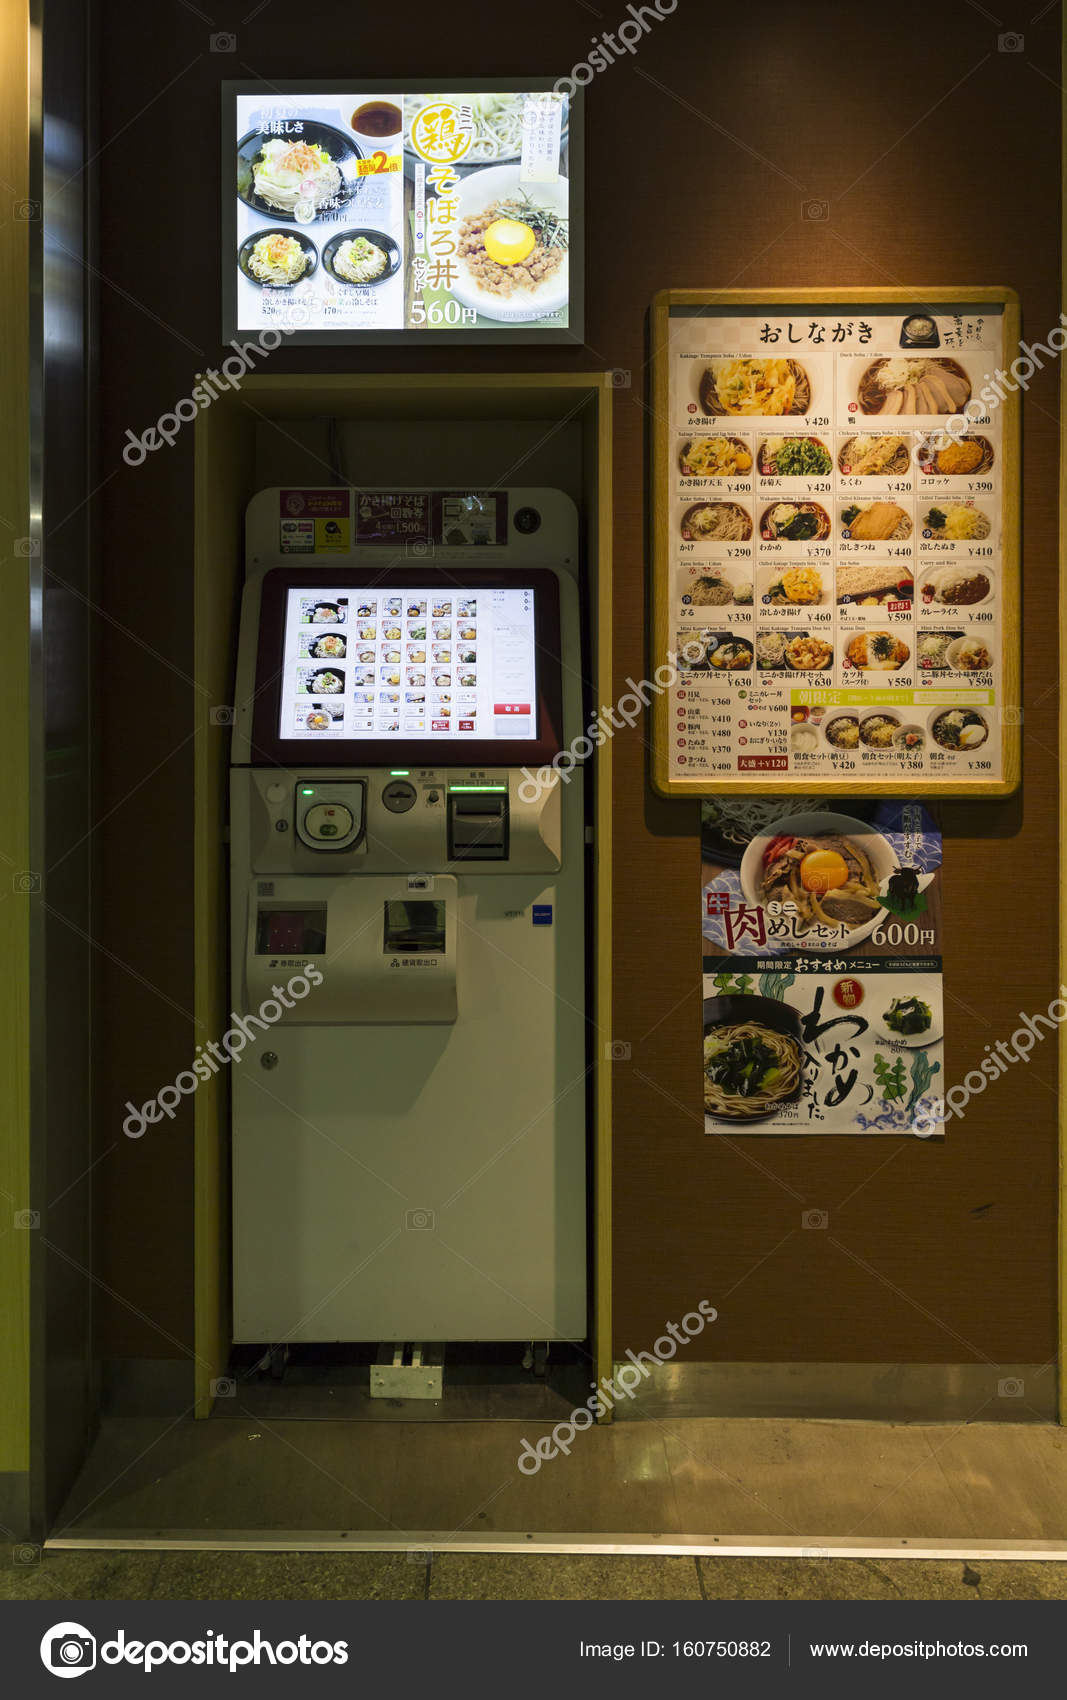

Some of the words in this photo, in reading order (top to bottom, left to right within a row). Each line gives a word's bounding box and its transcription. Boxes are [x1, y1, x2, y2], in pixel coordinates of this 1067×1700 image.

[459, 105, 473, 131] ミニ
[256, 120, 304, 135] 美味しさ
[420, 107, 467, 158] 鶏
[426, 168, 460, 288] そぼろ丼
[414, 259, 426, 291] セット
[410, 300, 477, 324] 560円
[760, 321, 873, 345] おしながき
[687, 417, 716, 426] かき揚げ
[804, 416, 829, 426] ¥420
[679, 478, 723, 487] かき揚げ天玉
[760, 478, 782, 487] 春菊天
[839, 478, 862, 486] ちくわ
[920, 477, 950, 486] コロッケ
[727, 483, 751, 492] ¥490
[807, 483, 831, 492] ¥420
[887, 482, 912, 491] ¥420
[968, 482, 993, 491] ¥390
[679, 543, 694, 552] かけ
[760, 543, 782, 552] わかめ
[839, 542, 876, 551] 冷しきつね
[919, 542, 957, 551] 冷したぬき
[727, 548, 751, 557] ¥290
[807, 548, 831, 557] ¥370
[887, 547, 912, 556] ¥440
[968, 547, 993, 556] ¥410
[679, 608, 695, 617] ざる
[759, 608, 801, 617] 冷しかき揚げ
[887, 612, 912, 621] ¥590
[920, 608, 959, 616] カレーライス
[968, 612, 993, 621] ¥400
[728, 613, 752, 622] ¥330
[807, 613, 831, 622] ¥460
[759, 671, 825, 680] ミニかき揚げ丼セット
[841, 671, 864, 680] カツ丼
[728, 678, 752, 687] ¥630
[808, 678, 832, 687] ¥630
[888, 677, 912, 687] ¥550
[968, 677, 993, 686] ¥590
[687, 690, 700, 698] 月見
[711, 698, 731, 706] ¥360
[768, 704, 788, 712] ¥600
[711, 715, 731, 723] ¥410
[768, 729, 788, 737] ¥130
[929, 752, 945, 761] 朝食
[832, 761, 856, 770] ¥420
[900, 761, 924, 770] ¥380
[968, 761, 992, 770] ¥380
[767, 900, 798, 914] ミニ
[870, 923, 935, 947] 600円
[756, 961, 792, 970] 期間限定
[793, 957, 847, 973] おすすめ
[849, 961, 881, 970] メニュー
